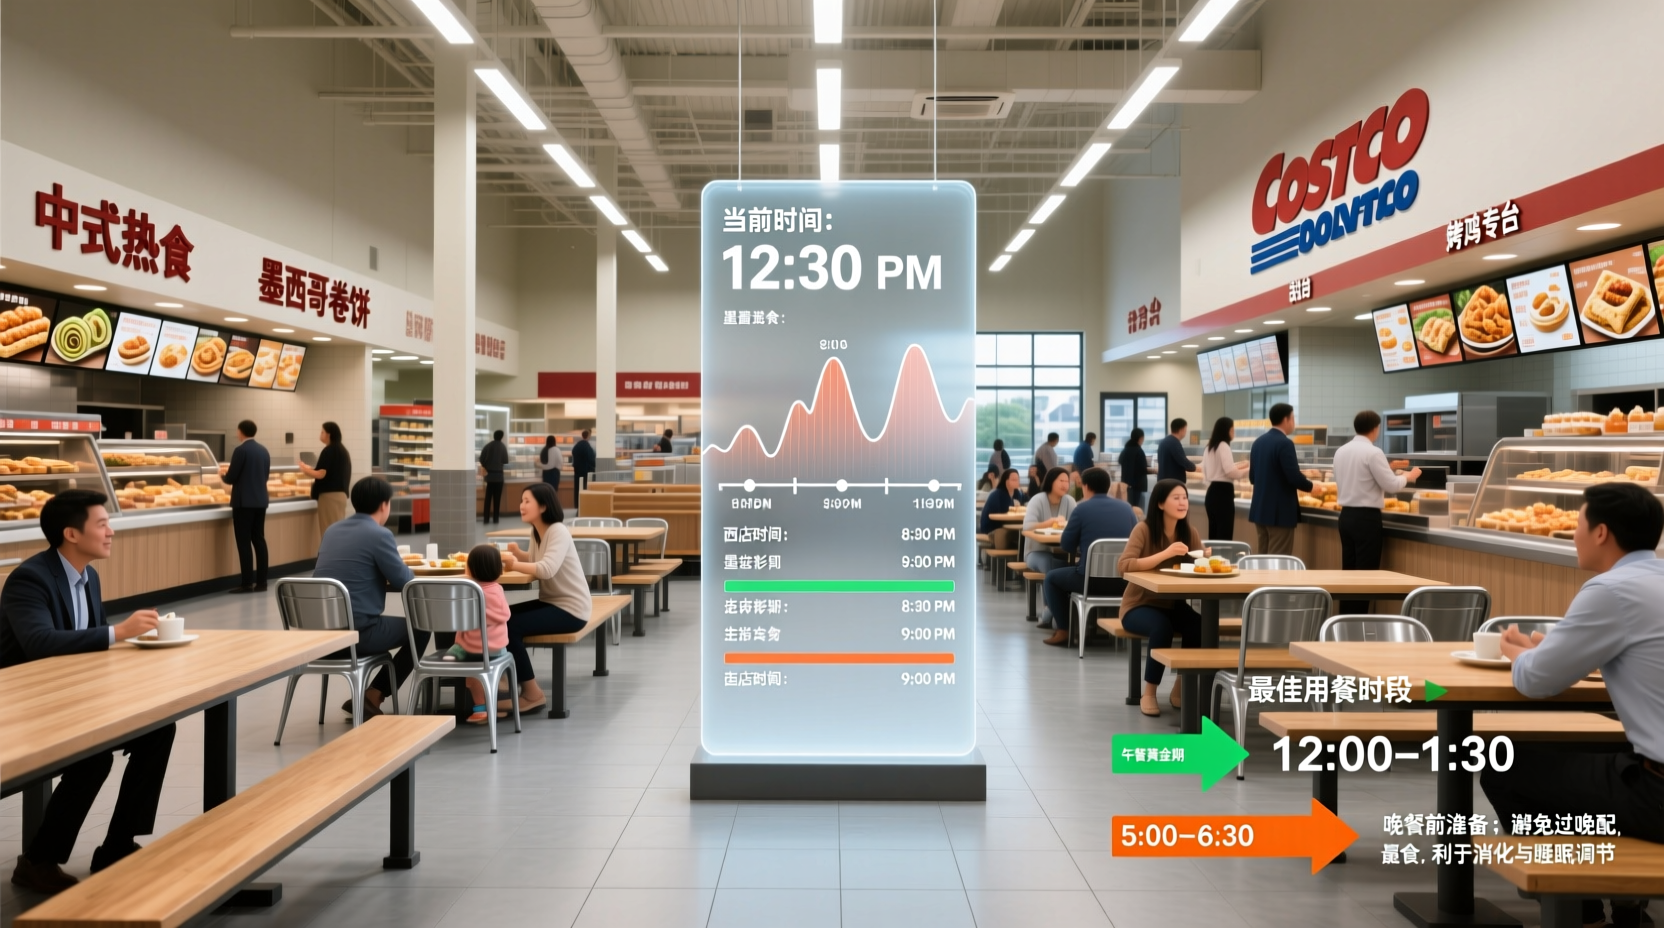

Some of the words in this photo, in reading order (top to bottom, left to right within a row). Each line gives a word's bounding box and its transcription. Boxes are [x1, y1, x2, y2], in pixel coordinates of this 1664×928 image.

[1252, 88, 1429, 235] COSTCO
[722, 206, 833, 233] 当前时间：
[35, 183, 194, 283] 中式热食
[722, 244, 862, 290] 12:30
[878, 254, 942, 290] PM
[258, 257, 371, 329] 墨西哥卷饼
[934, 527, 956, 541] PM
[901, 555, 932, 569] 9:00
[934, 555, 956, 569] PM
[934, 599, 956, 613] PM
[901, 627, 932, 641] 9:00
[934, 627, 956, 641] PM
[901, 672, 932, 686] 9:00
[934, 672, 956, 686] PM
